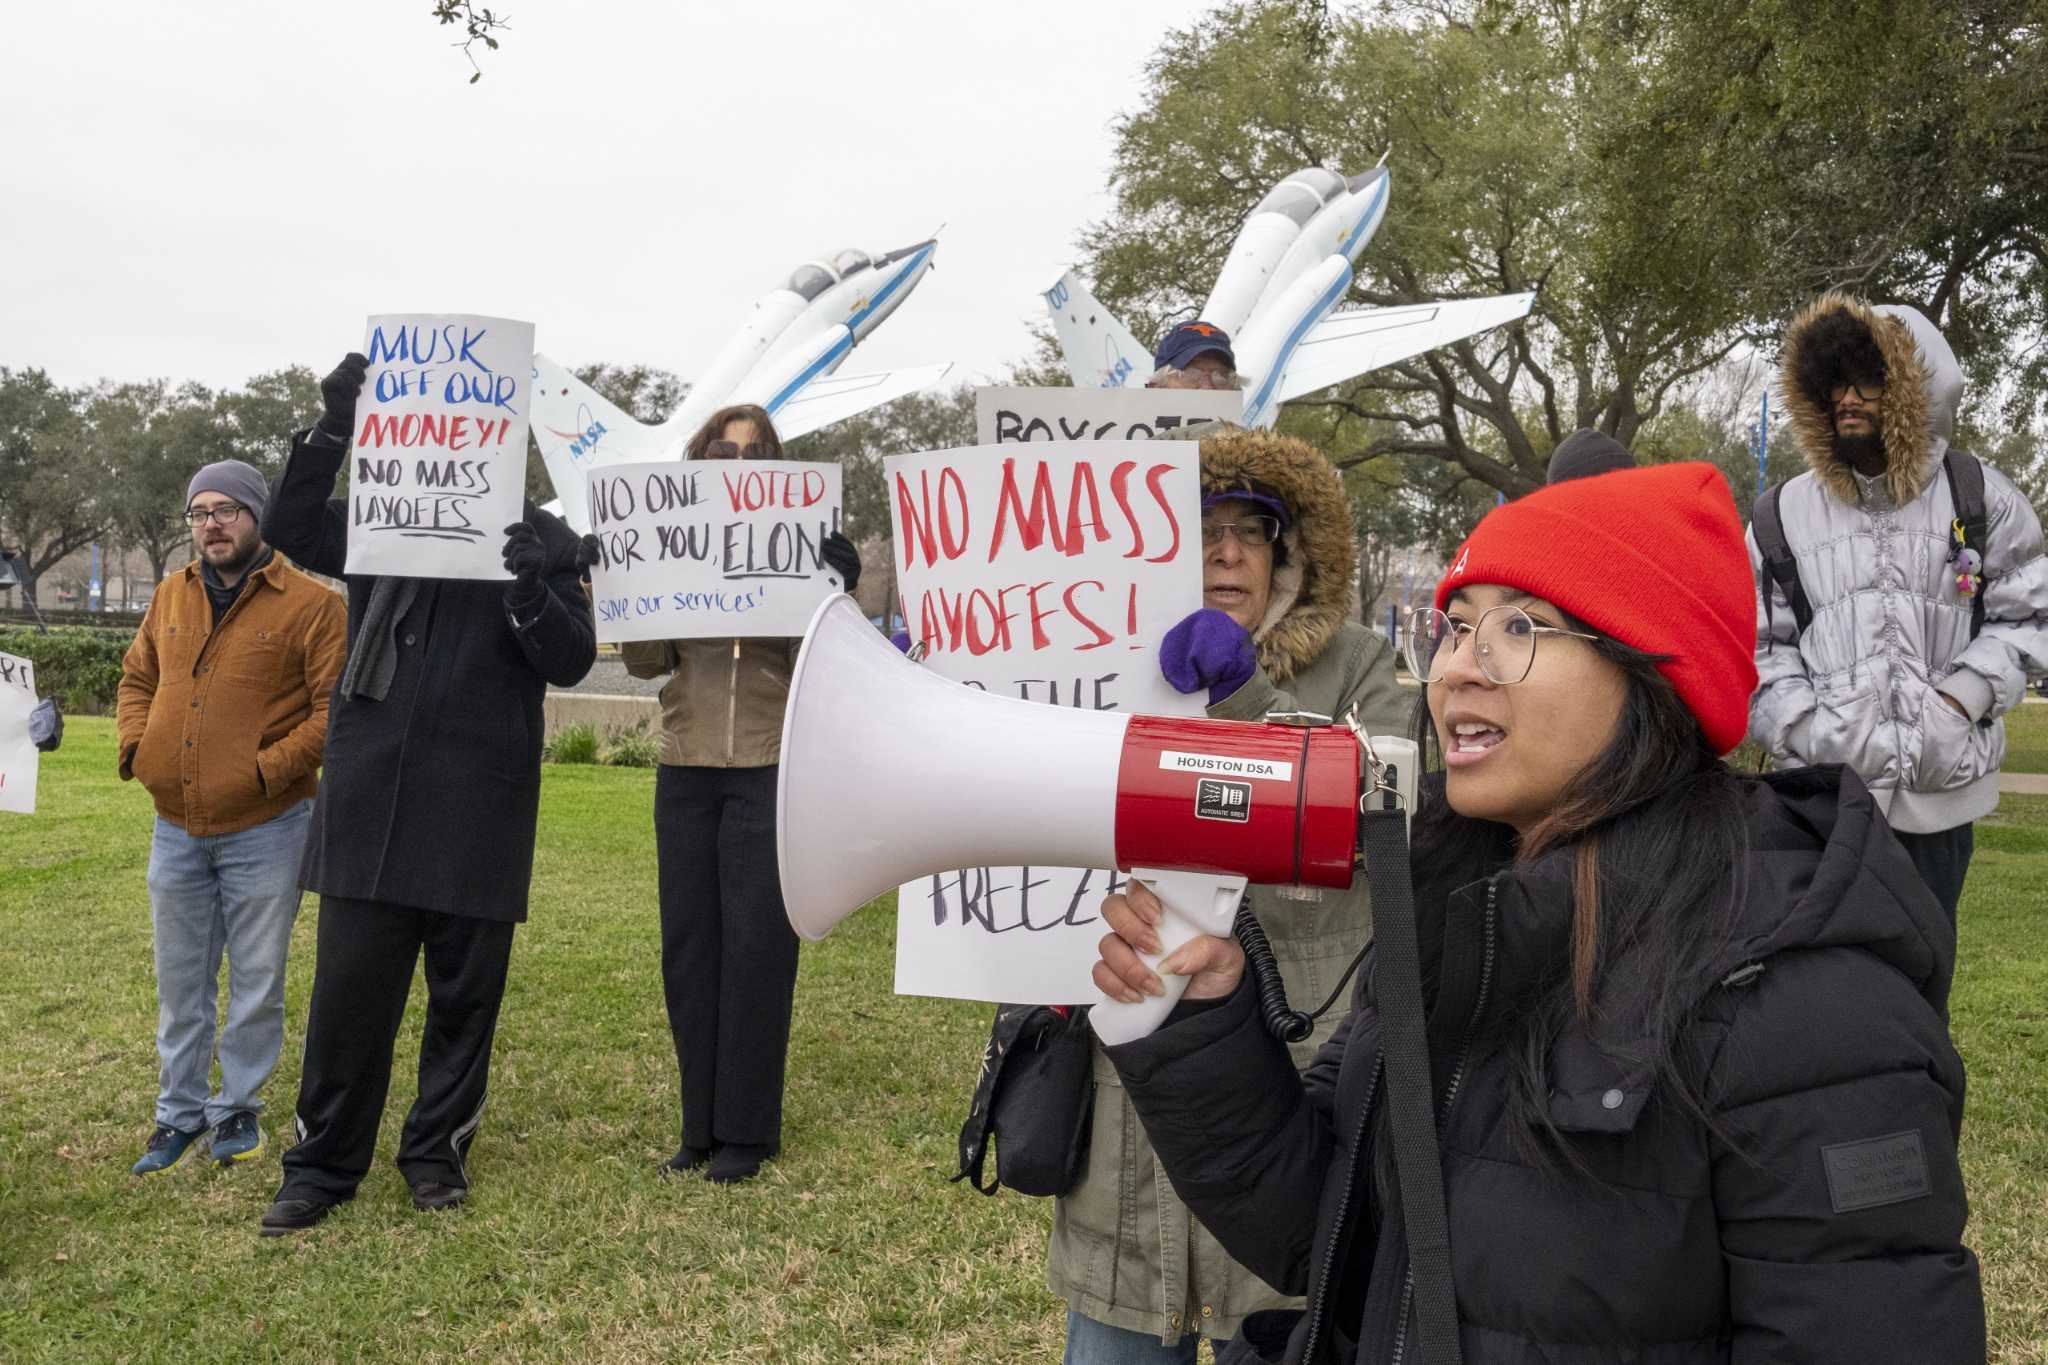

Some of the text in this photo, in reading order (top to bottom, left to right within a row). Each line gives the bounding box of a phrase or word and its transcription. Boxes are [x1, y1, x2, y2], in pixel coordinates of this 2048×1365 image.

[368, 324, 493, 373] MUSK
[376, 369, 518, 415] OFF OUR
[358, 413, 511, 451] MONEY!
[569, 421, 608, 459] NASA
[358, 458, 491, 494] NO MASS
[355, 495, 473, 529] LAYOFFS
[592, 469, 826, 528] NO ONE VOTED
[896, 457, 1181, 572] NO MASS
[600, 527, 646, 572] FOR
[656, 522, 718, 566] YOU,
[635, 594, 665, 616] our
[1177, 756, 1274, 775] HOUSTON DSA
